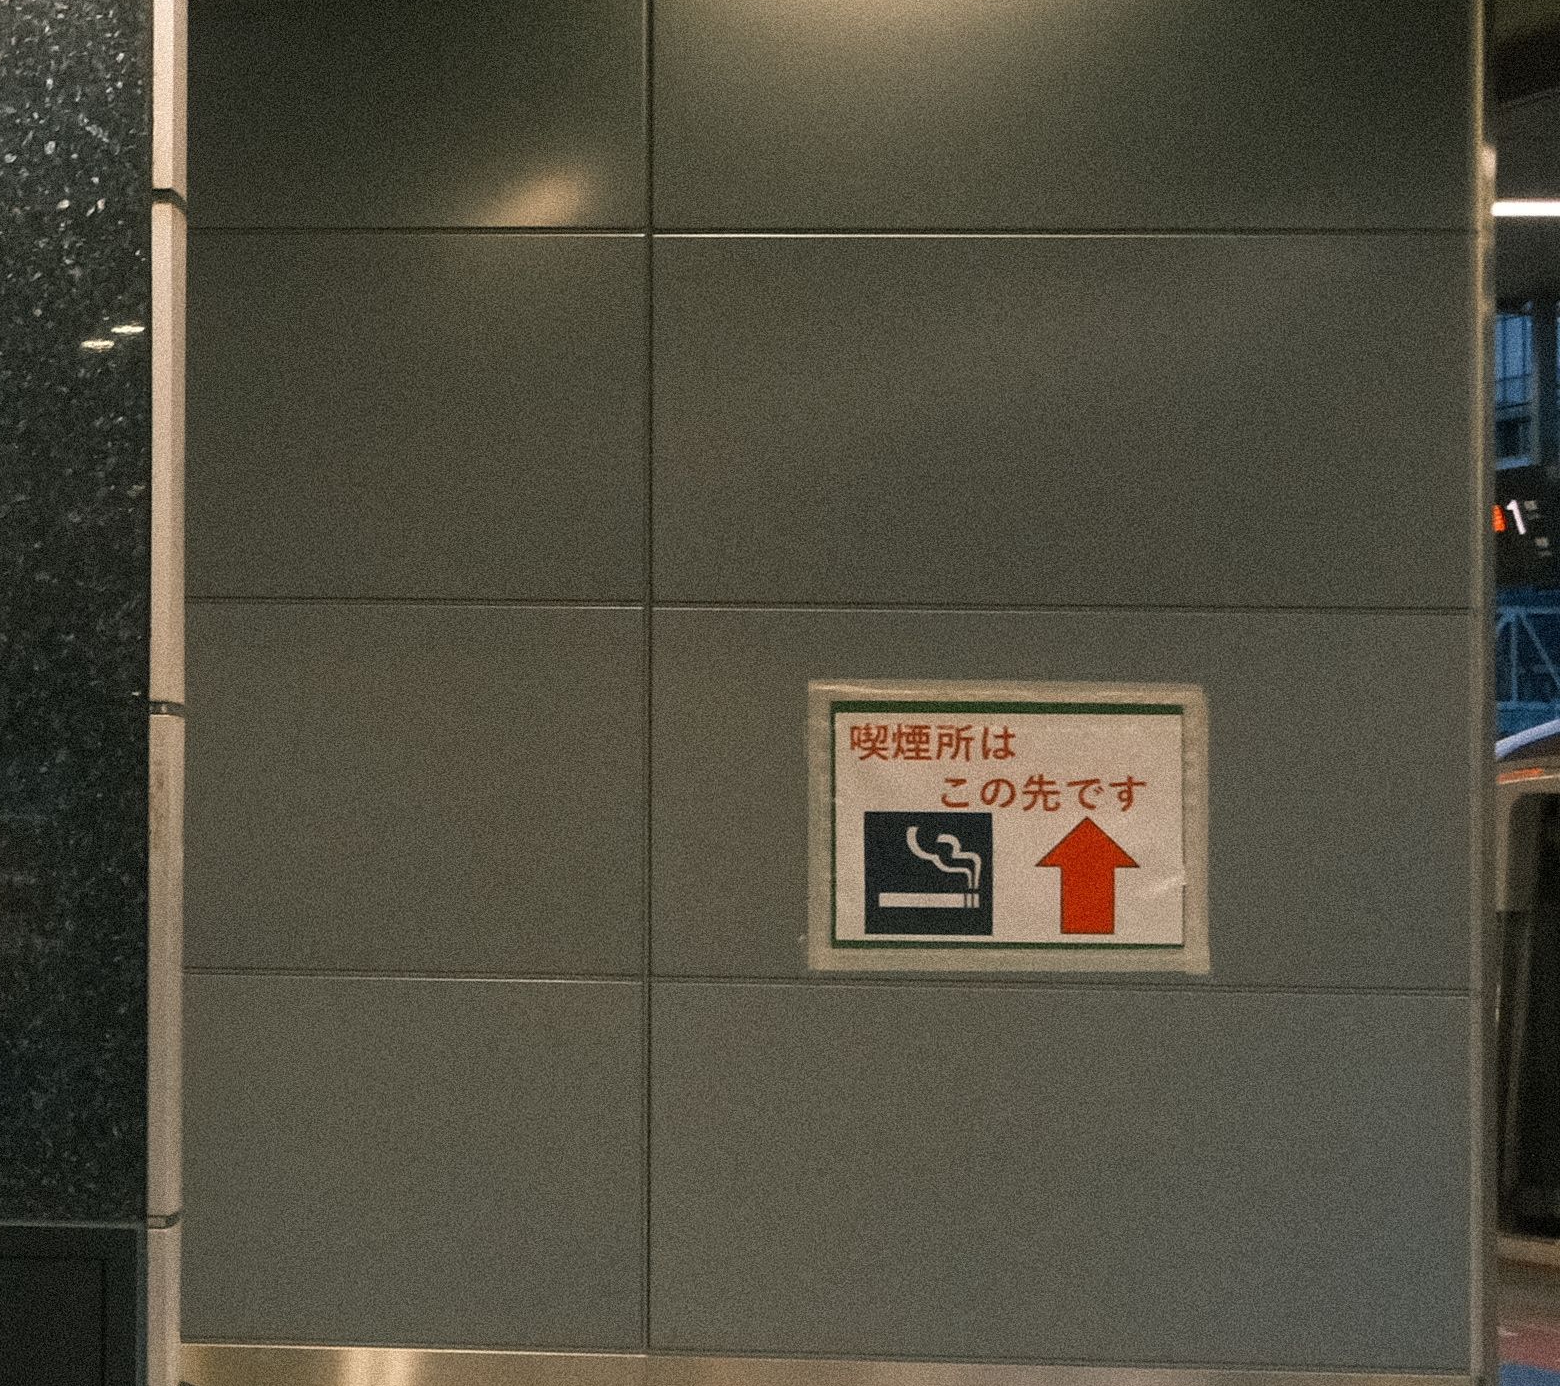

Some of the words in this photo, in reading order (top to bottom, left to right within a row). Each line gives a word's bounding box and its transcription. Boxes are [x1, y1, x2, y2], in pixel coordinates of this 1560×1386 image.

[1505, 499, 1527, 535] 1
[849, 723, 1017, 762] 喫煙所は
[940, 773, 1147, 811] この先です
